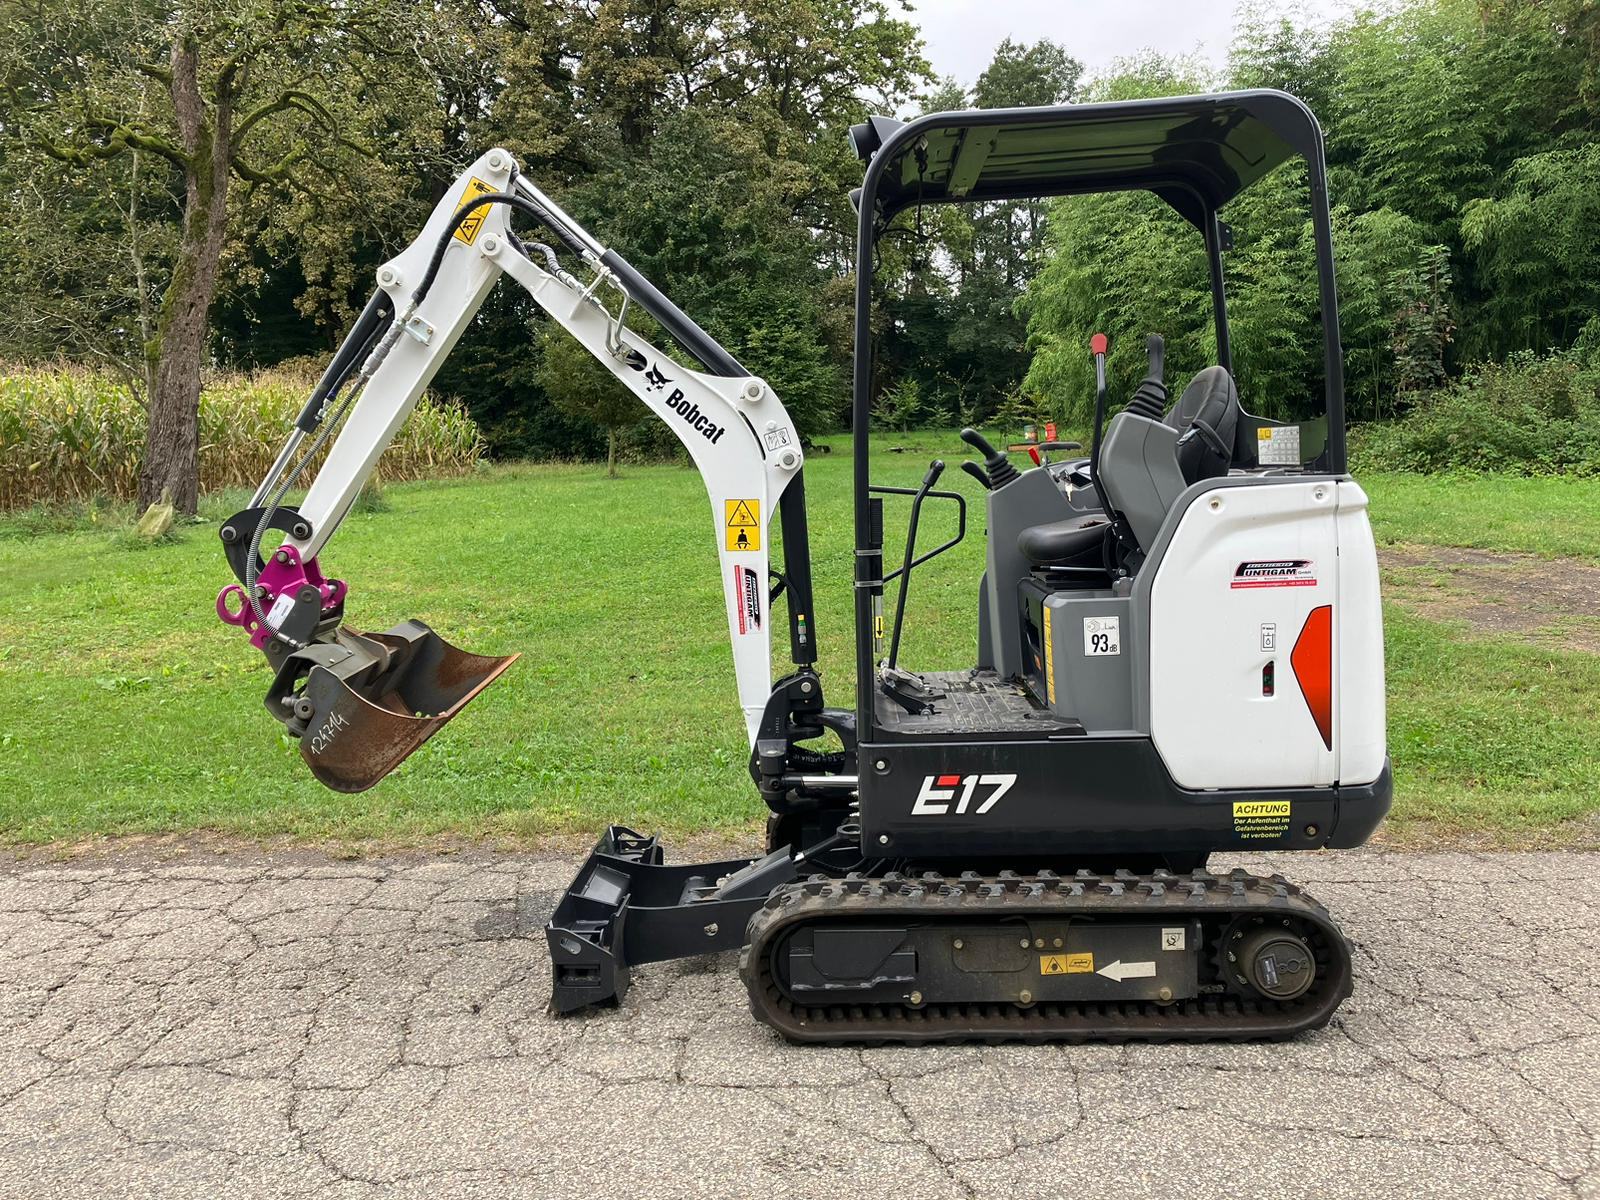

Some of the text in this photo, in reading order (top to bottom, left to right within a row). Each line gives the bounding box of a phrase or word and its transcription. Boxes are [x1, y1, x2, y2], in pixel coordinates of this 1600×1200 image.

[665, 388, 726, 445] Bobcat
[1091, 633, 1118, 653] 93 dB
[311, 711, 350, 755] 124714
[911, 774, 1018, 815] E17
[1235, 804, 1289, 814] ACHTUNG
